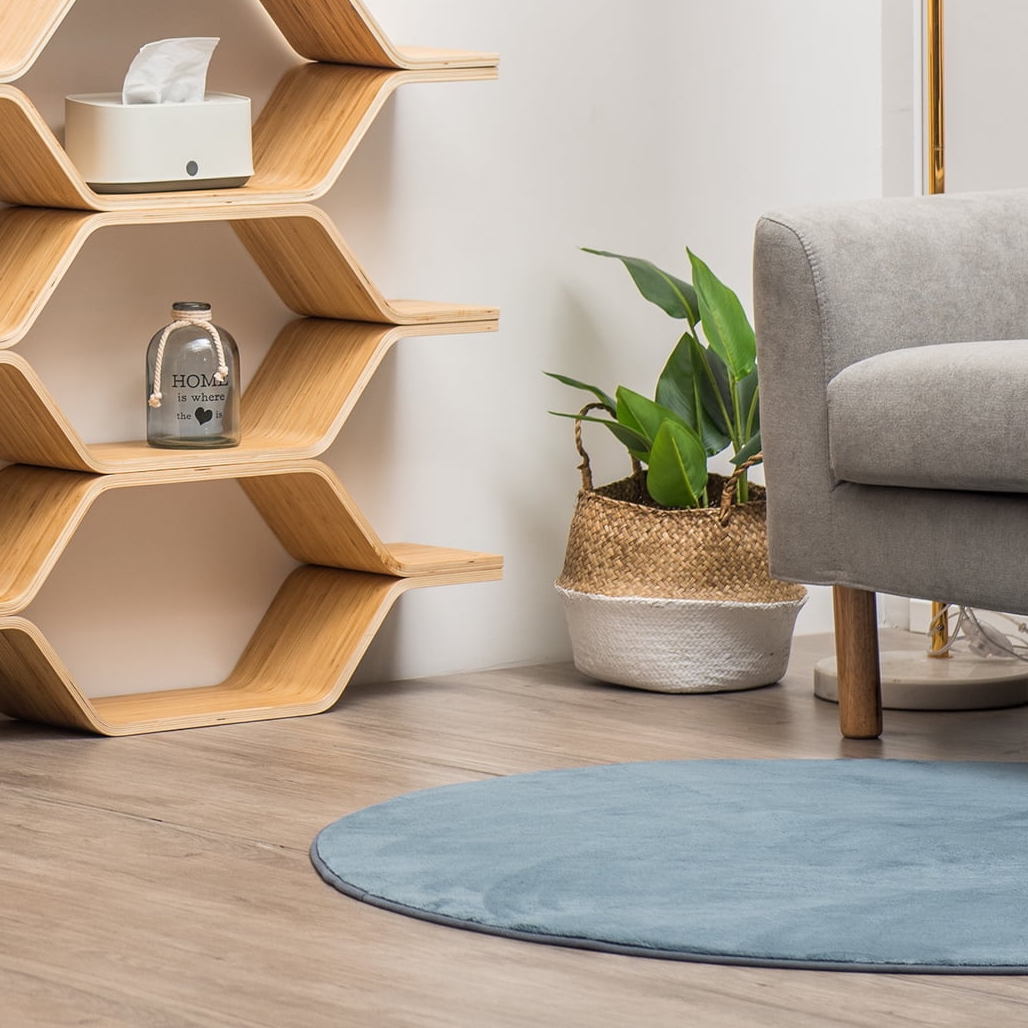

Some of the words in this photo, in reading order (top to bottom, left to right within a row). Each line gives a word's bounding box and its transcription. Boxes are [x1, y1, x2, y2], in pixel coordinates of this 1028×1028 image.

[177, 392, 187, 403] is
[191, 392, 225, 403] where
[176, 411, 192, 420] the
